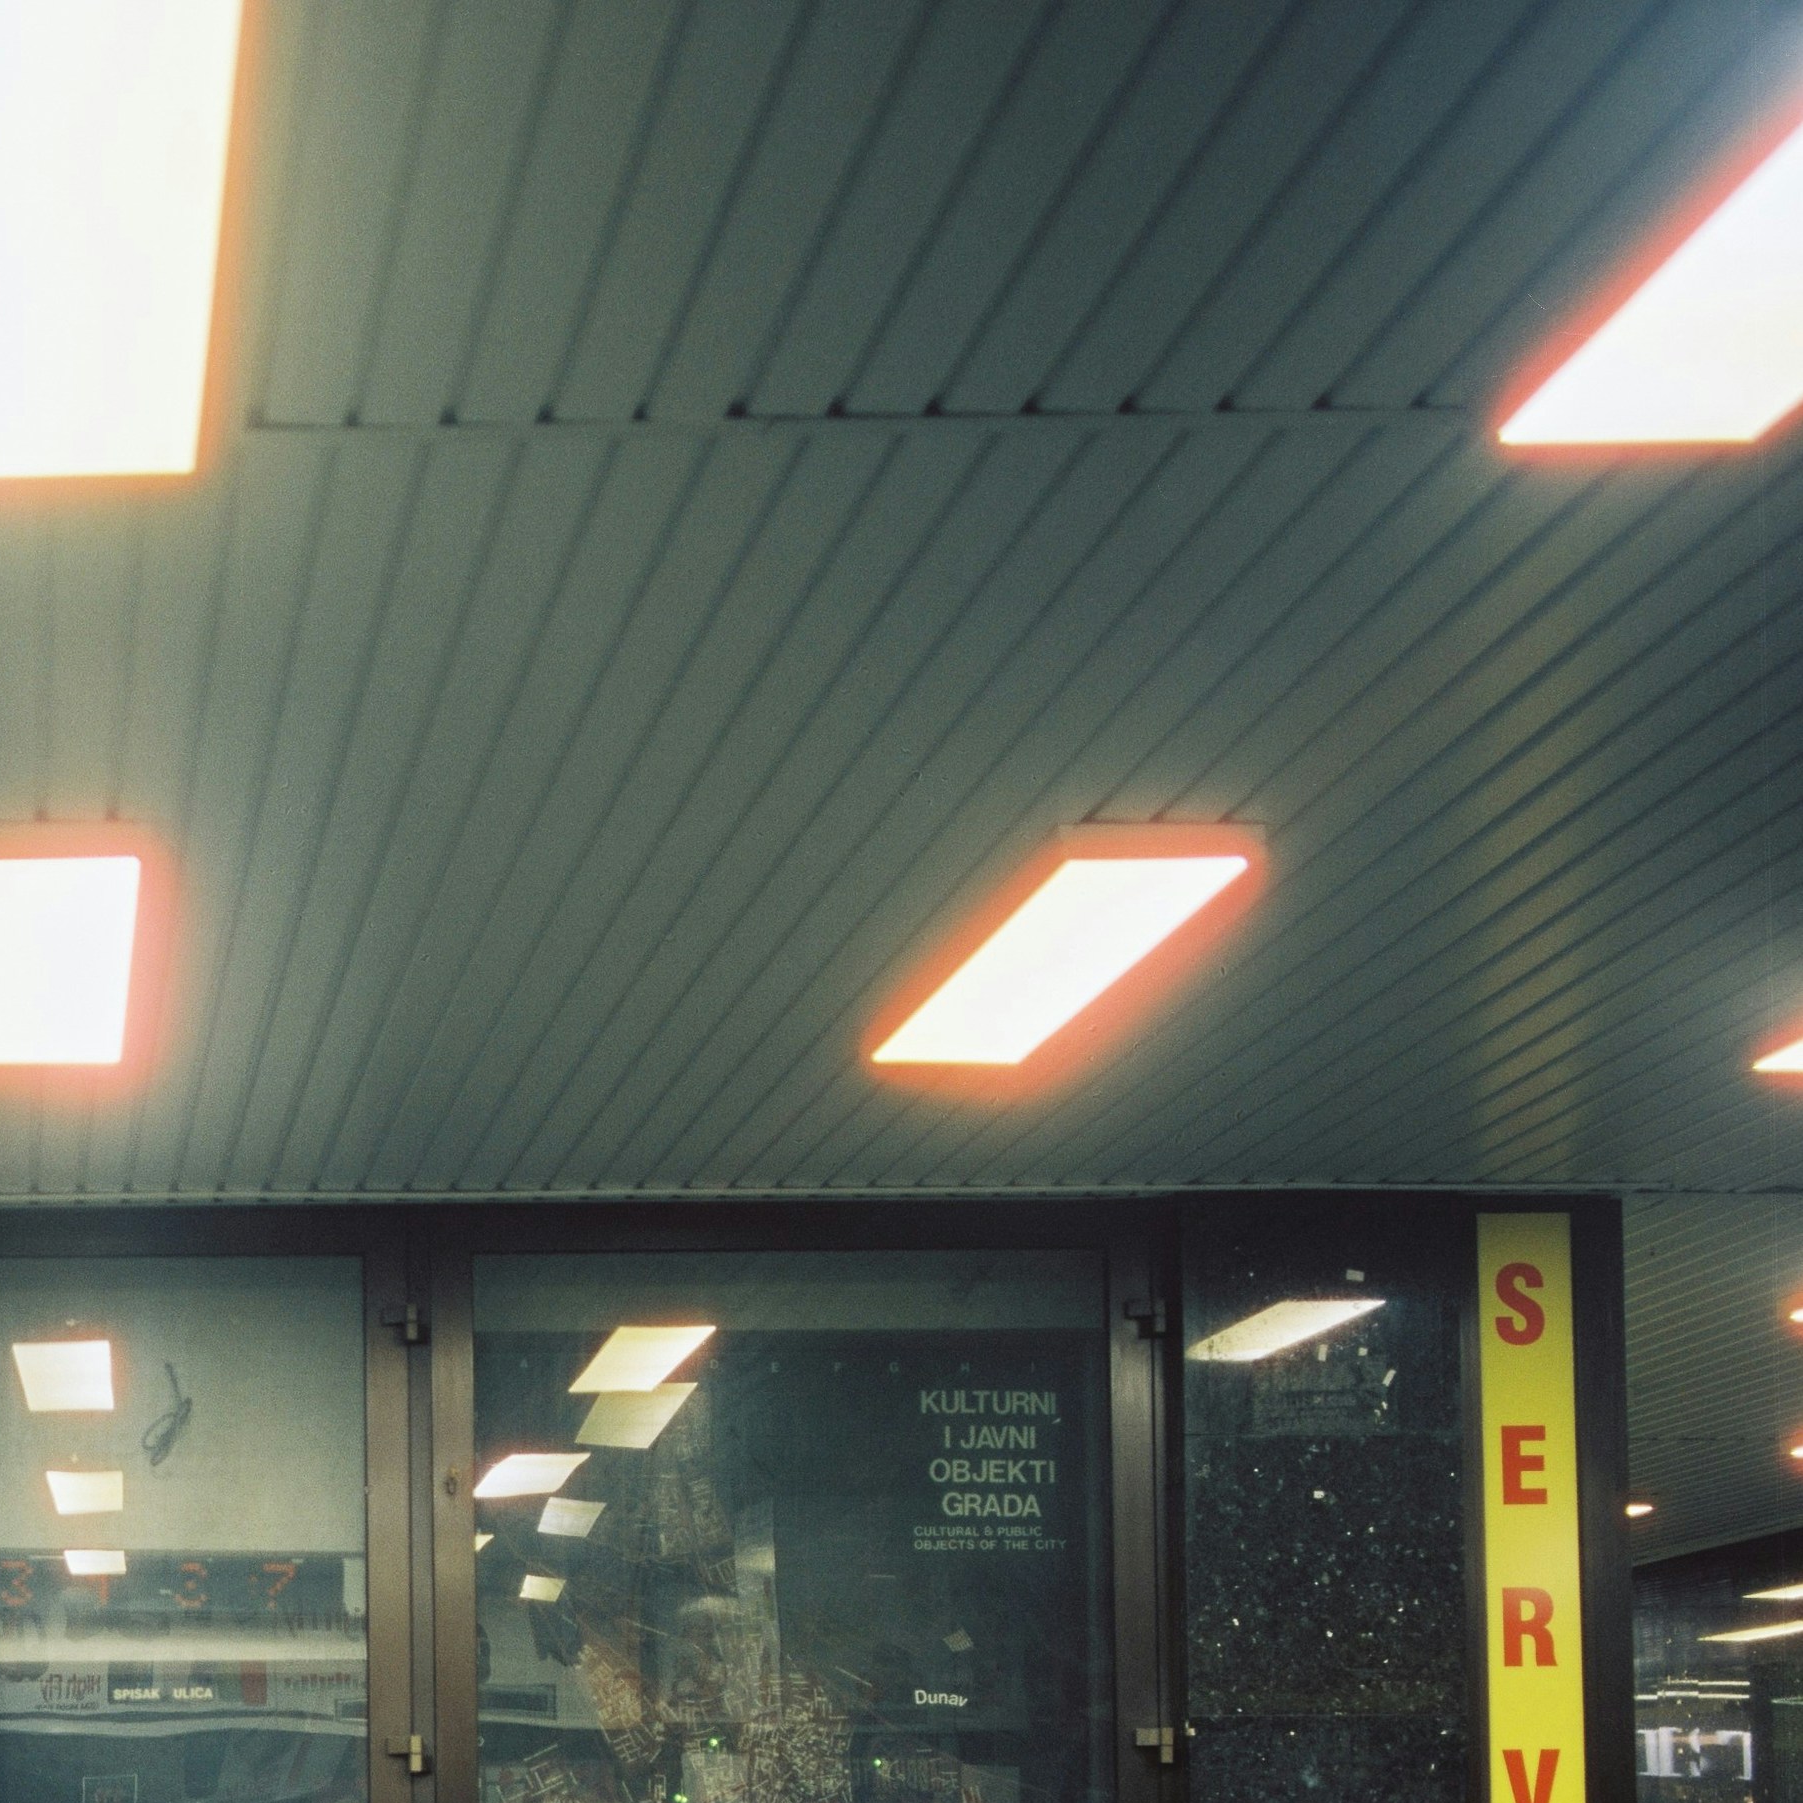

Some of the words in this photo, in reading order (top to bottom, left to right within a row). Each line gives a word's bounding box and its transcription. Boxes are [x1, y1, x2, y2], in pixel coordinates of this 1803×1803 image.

[920, 1389, 1057, 1416] KULTURNI
[944, 1425, 953, 1449] I
[959, 1425, 1036, 1450] JAVNI
[928, 1458, 1056, 1484] OBJEKTI
[941, 1491, 1042, 1518] GRADA
[913, 1525, 980, 1538] CULTURAL
[983, 1525, 994, 1537] &
[997, 1525, 1042, 1538] PUBLIC
[913, 1538, 975, 1551] OBJECTS
[979, 1539, 997, 1551] OF
[1003, 1539, 1029, 1551] THE
[1034, 1538, 1066, 1551] CITY
[113, 1686, 161, 1701] SPISAK
[172, 1686, 214, 1700] ULICA
[913, 1688, 970, 1708] Dunav
